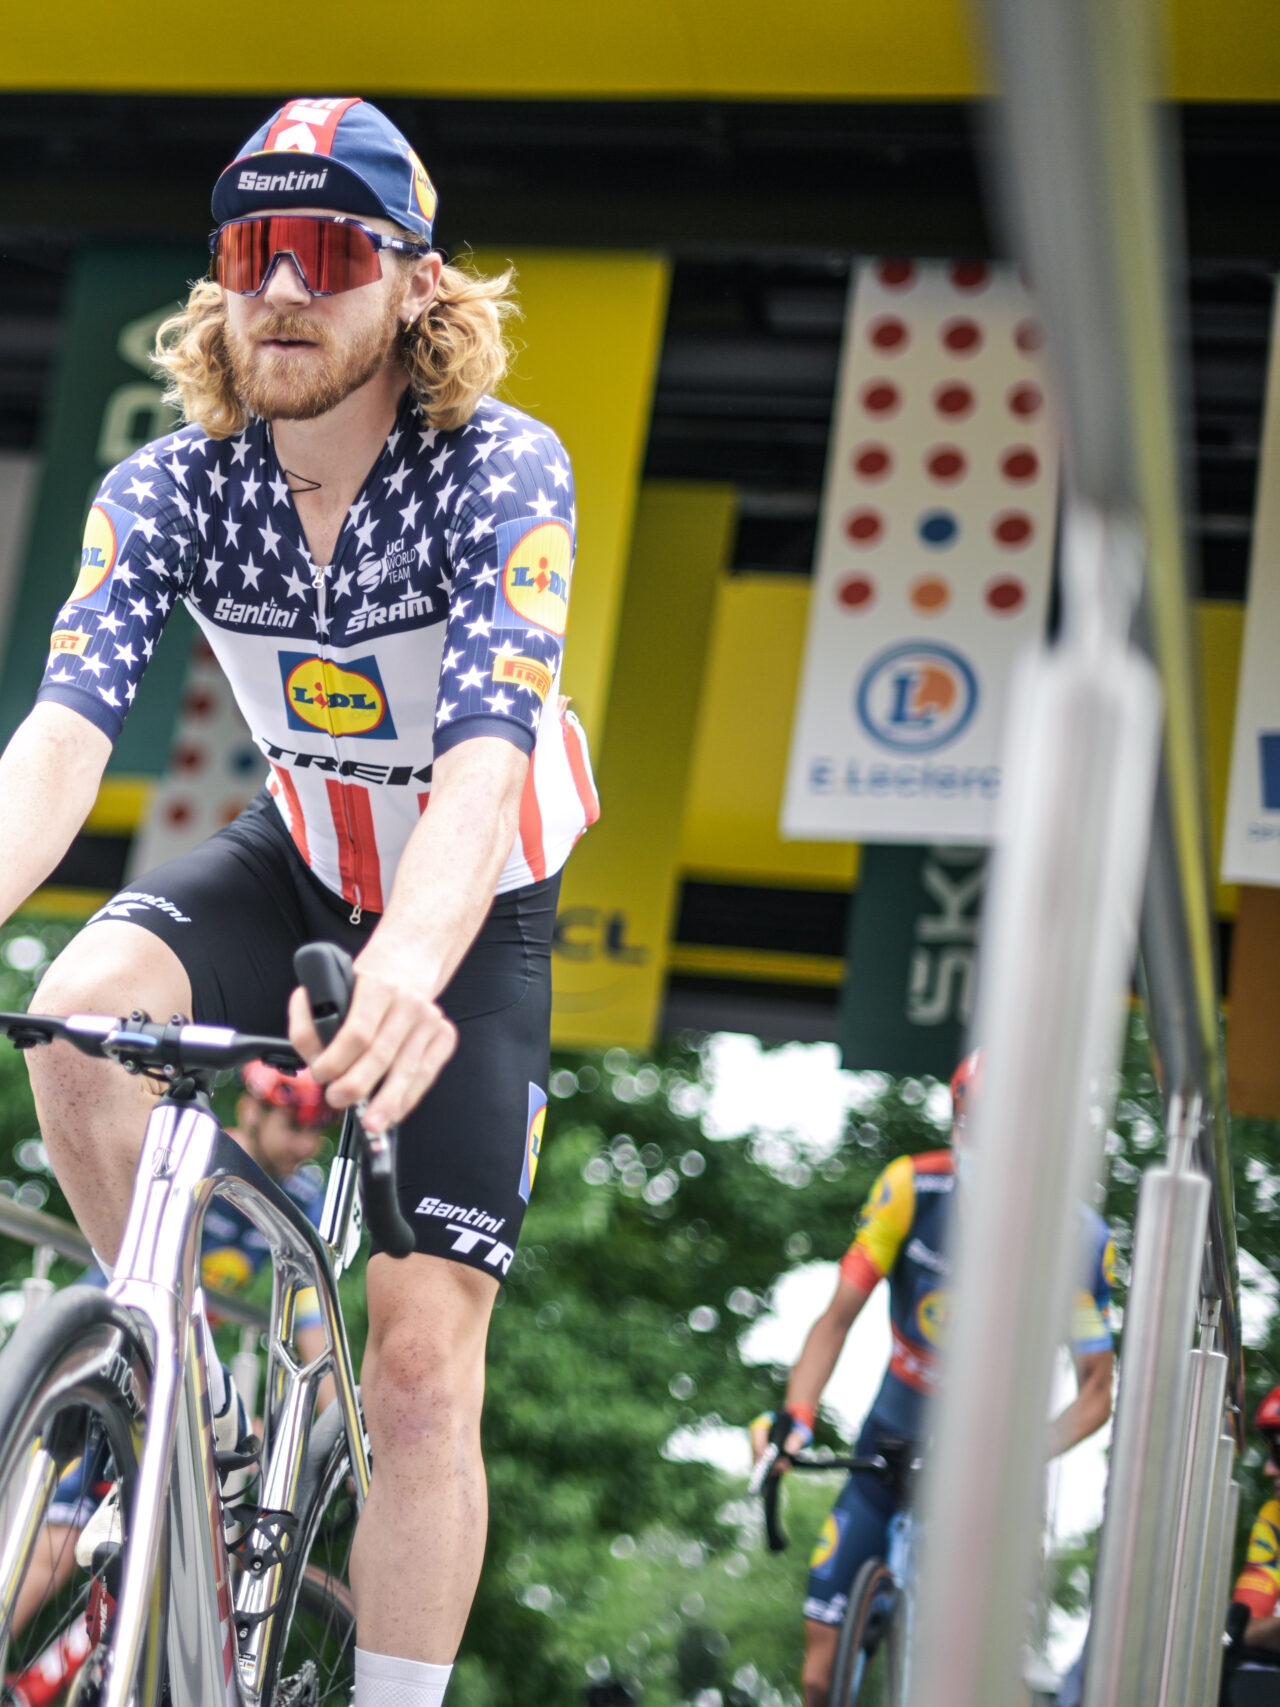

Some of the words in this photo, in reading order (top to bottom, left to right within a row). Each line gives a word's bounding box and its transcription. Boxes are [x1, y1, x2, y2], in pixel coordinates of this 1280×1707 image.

[237, 168, 328, 192] Santini
[386, 548, 416, 570] WORLD
[388, 565, 411, 584] TEAM
[213, 596, 300, 629] Santini
[344, 595, 434, 635] SRAM
[415, 1197, 506, 1233] Santini
